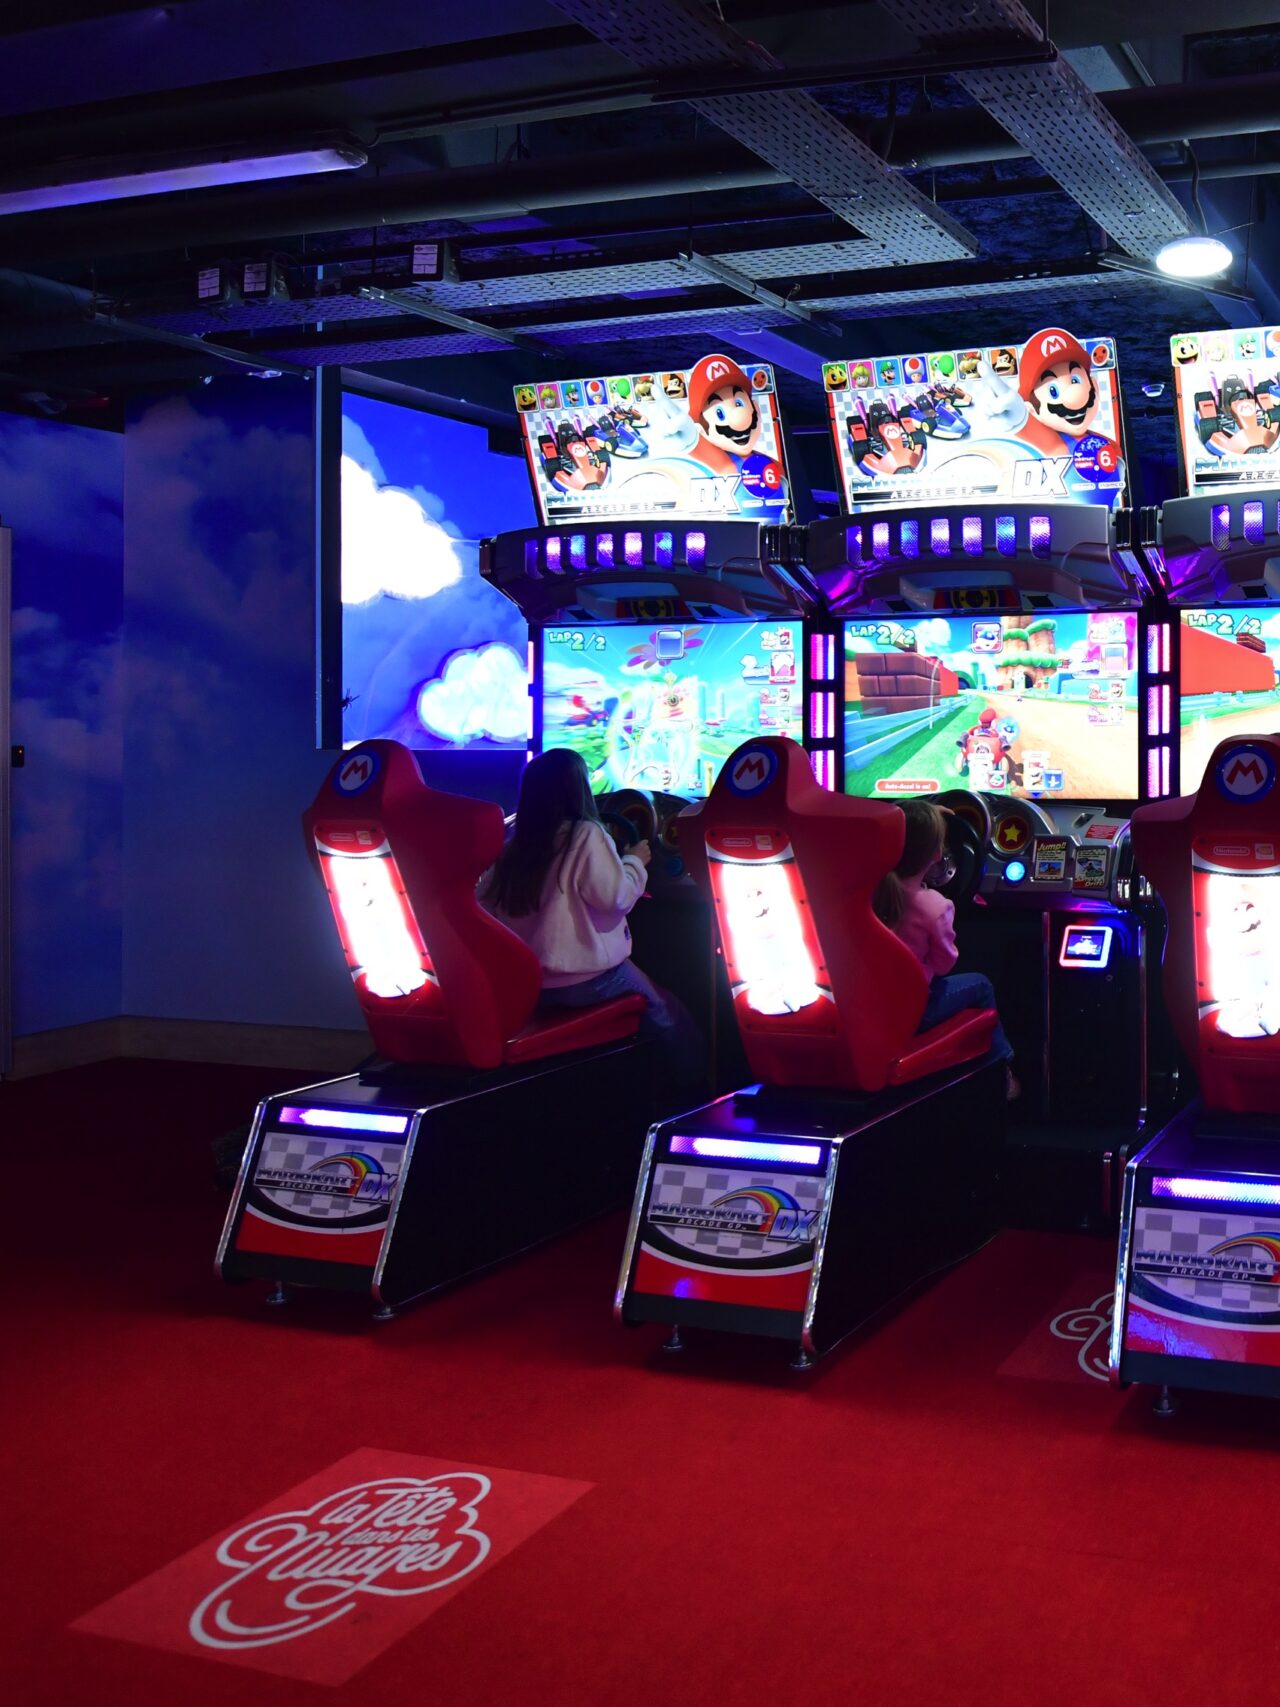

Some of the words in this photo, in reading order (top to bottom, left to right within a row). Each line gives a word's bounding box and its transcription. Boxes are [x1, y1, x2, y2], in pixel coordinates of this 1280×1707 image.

[1043, 338, 1067, 357] M
[709, 360, 727, 379] M
[1099, 450, 1112, 467] 6
[764, 468, 776, 484] 6
[1013, 456, 1071, 497] DX
[690, 475, 740, 513] DX
[850, 624, 877, 639] LAP
[875, 625, 917, 646] 2/2
[1187, 613, 1218, 628] LAP
[1217, 614, 1263, 636] 2/2
[548, 630, 572, 645] LAP
[571, 631, 607, 652] 2/2
[341, 760, 369, 782] M
[734, 757, 765, 781] M
[1225, 758, 1265, 785] M
[354, 1172, 399, 1203] DX
[677, 1217, 722, 1229] ARCADE
[766, 1207, 821, 1243] DX
[1169, 1265, 1224, 1279] ARCADE
[319, 1491, 368, 1526] la
[329, 1487, 458, 1545] Tête
[339, 1528, 404, 1546] dans
[402, 1525, 436, 1543] les
